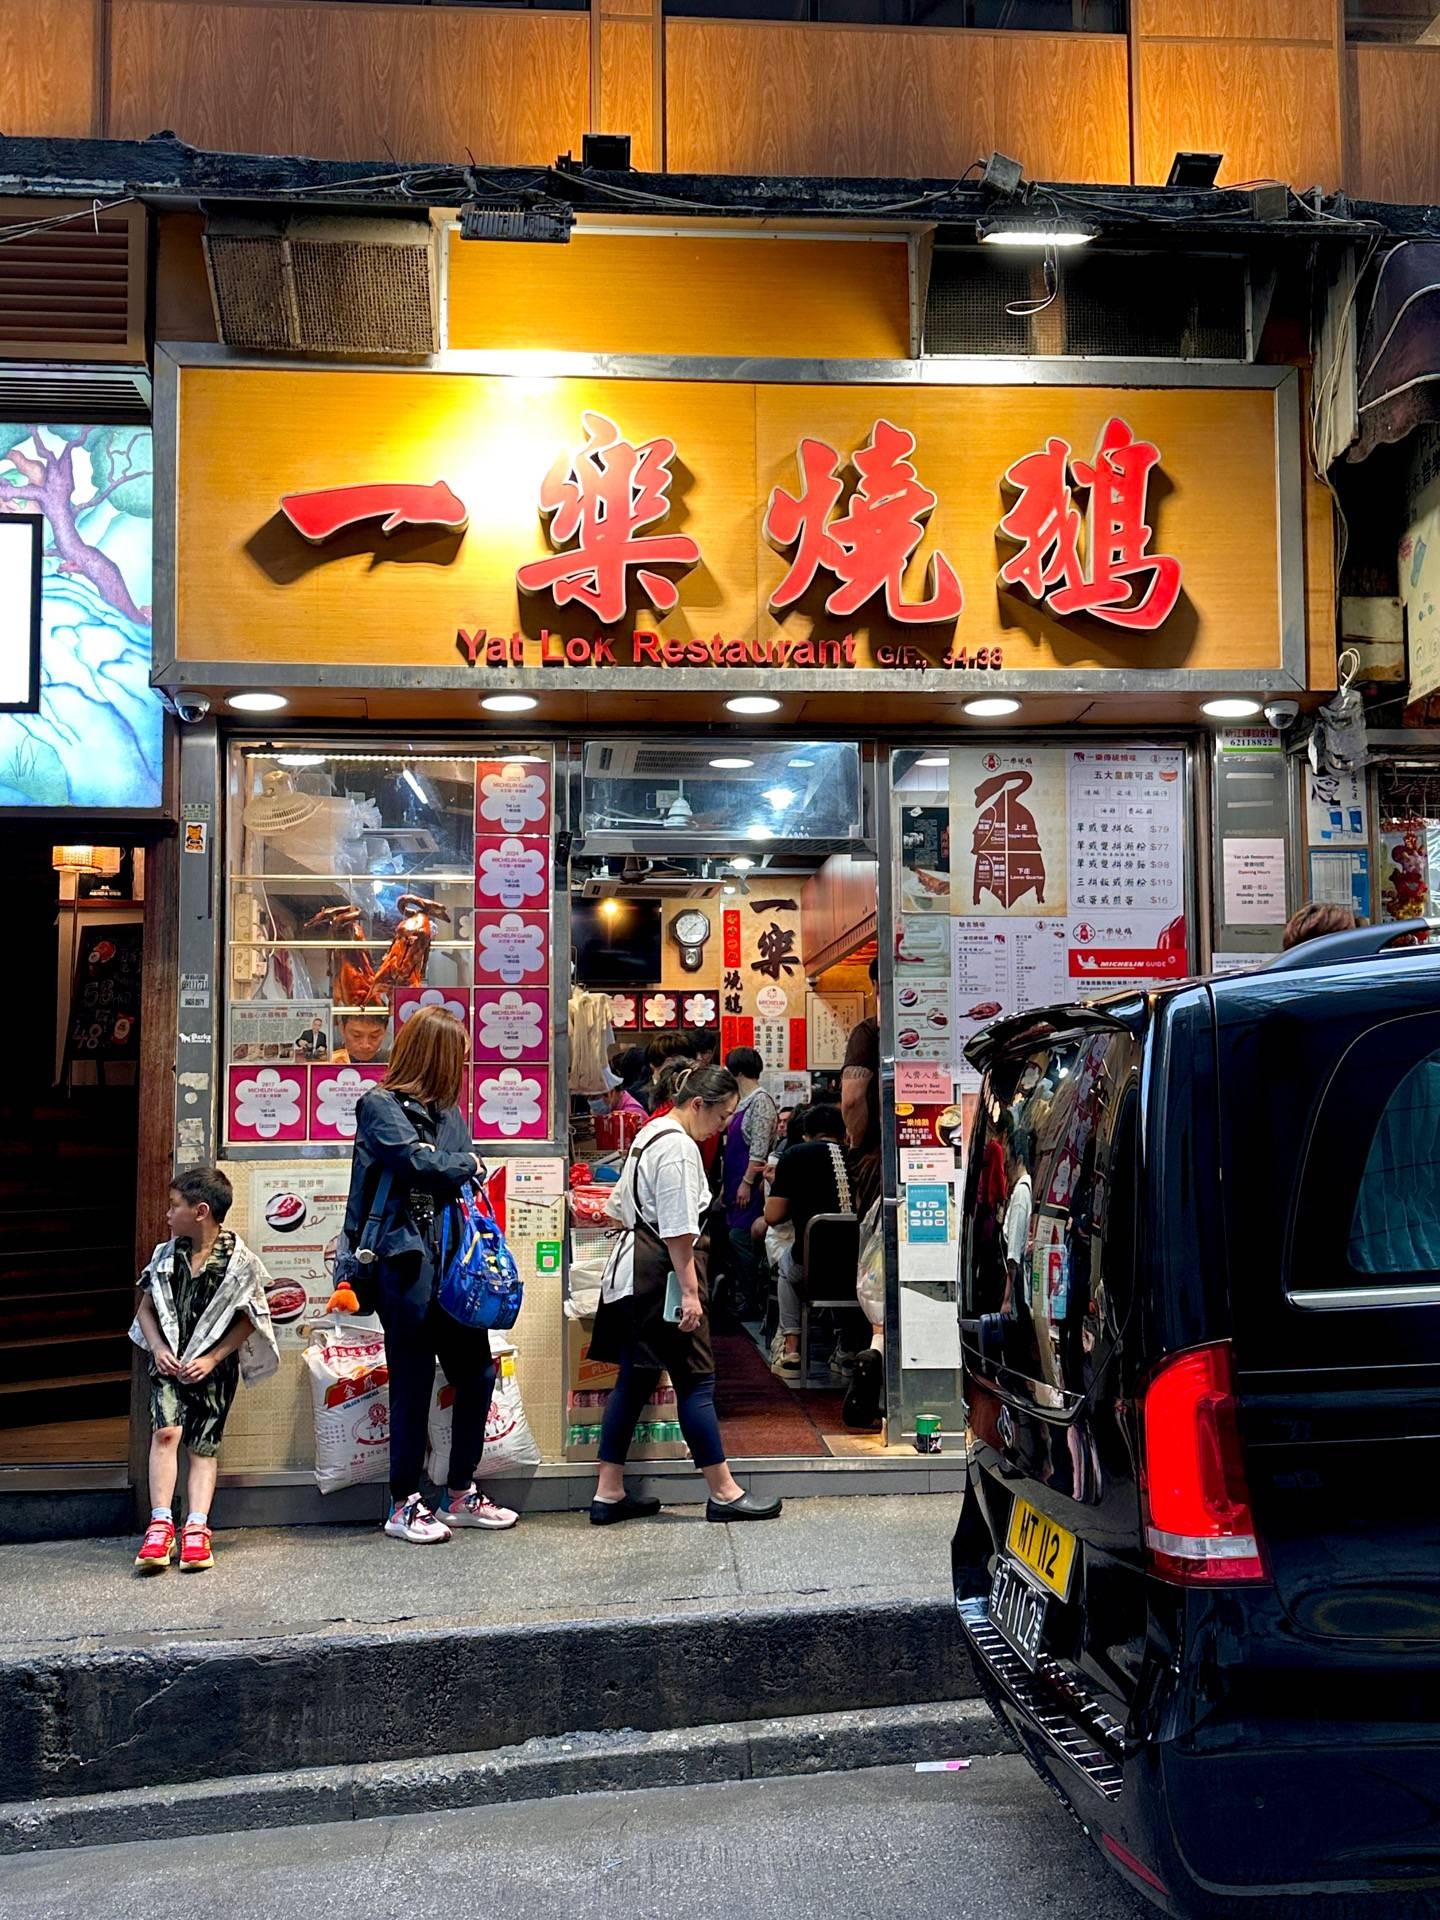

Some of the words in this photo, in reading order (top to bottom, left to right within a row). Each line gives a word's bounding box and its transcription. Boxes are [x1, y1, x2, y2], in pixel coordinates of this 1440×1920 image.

[280, 410, 1182, 629] 一樂燒鵝
[457, 629, 525, 666] Yat
[541, 629, 616, 666] Lok
[633, 630, 857, 667] Restaurant
[750, 898, 800, 981] 一樂
